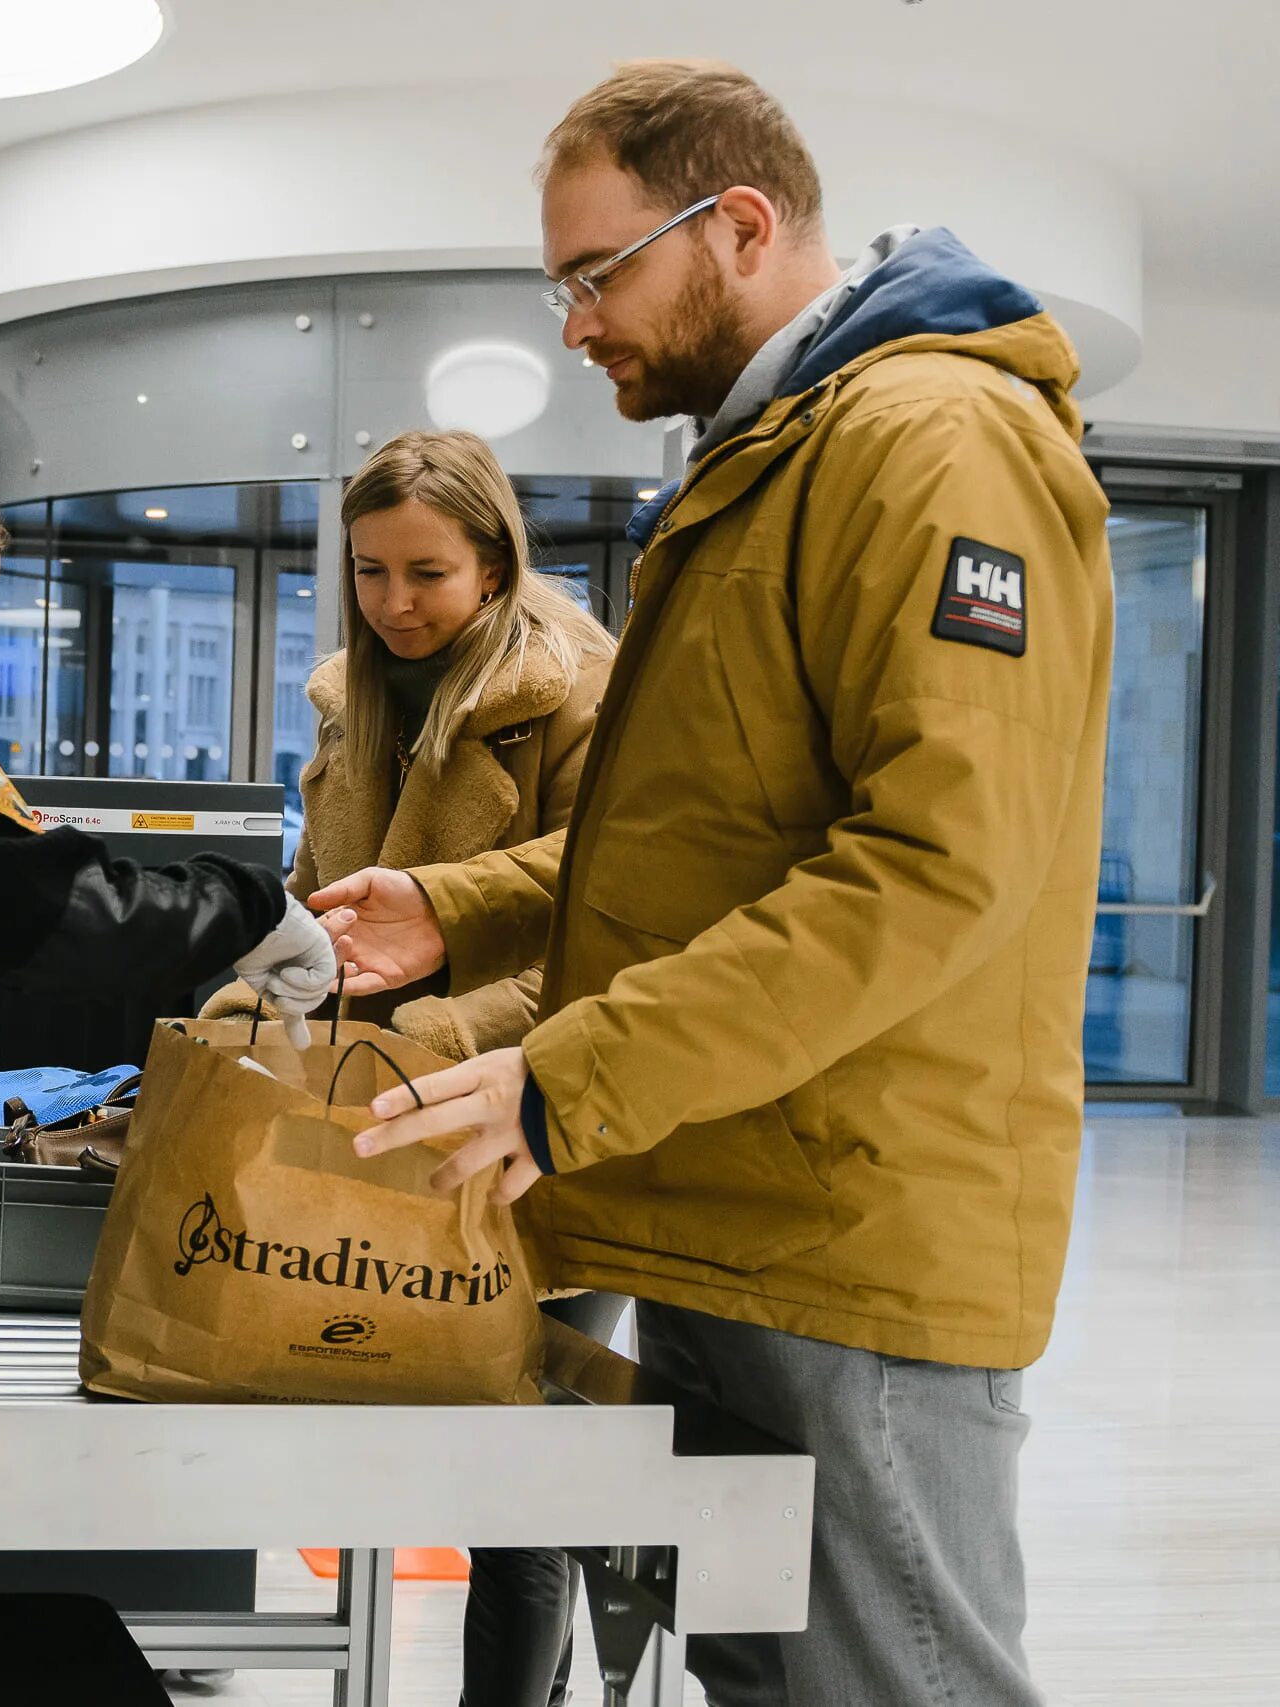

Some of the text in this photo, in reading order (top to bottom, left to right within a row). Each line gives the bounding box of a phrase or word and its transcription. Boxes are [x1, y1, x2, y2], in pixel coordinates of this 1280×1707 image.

[956, 555, 1022, 609] HH
[43, 814, 83, 824] ProScan
[288, 1344, 392, 1360] ЕВРОПЕЙСКИЙ
